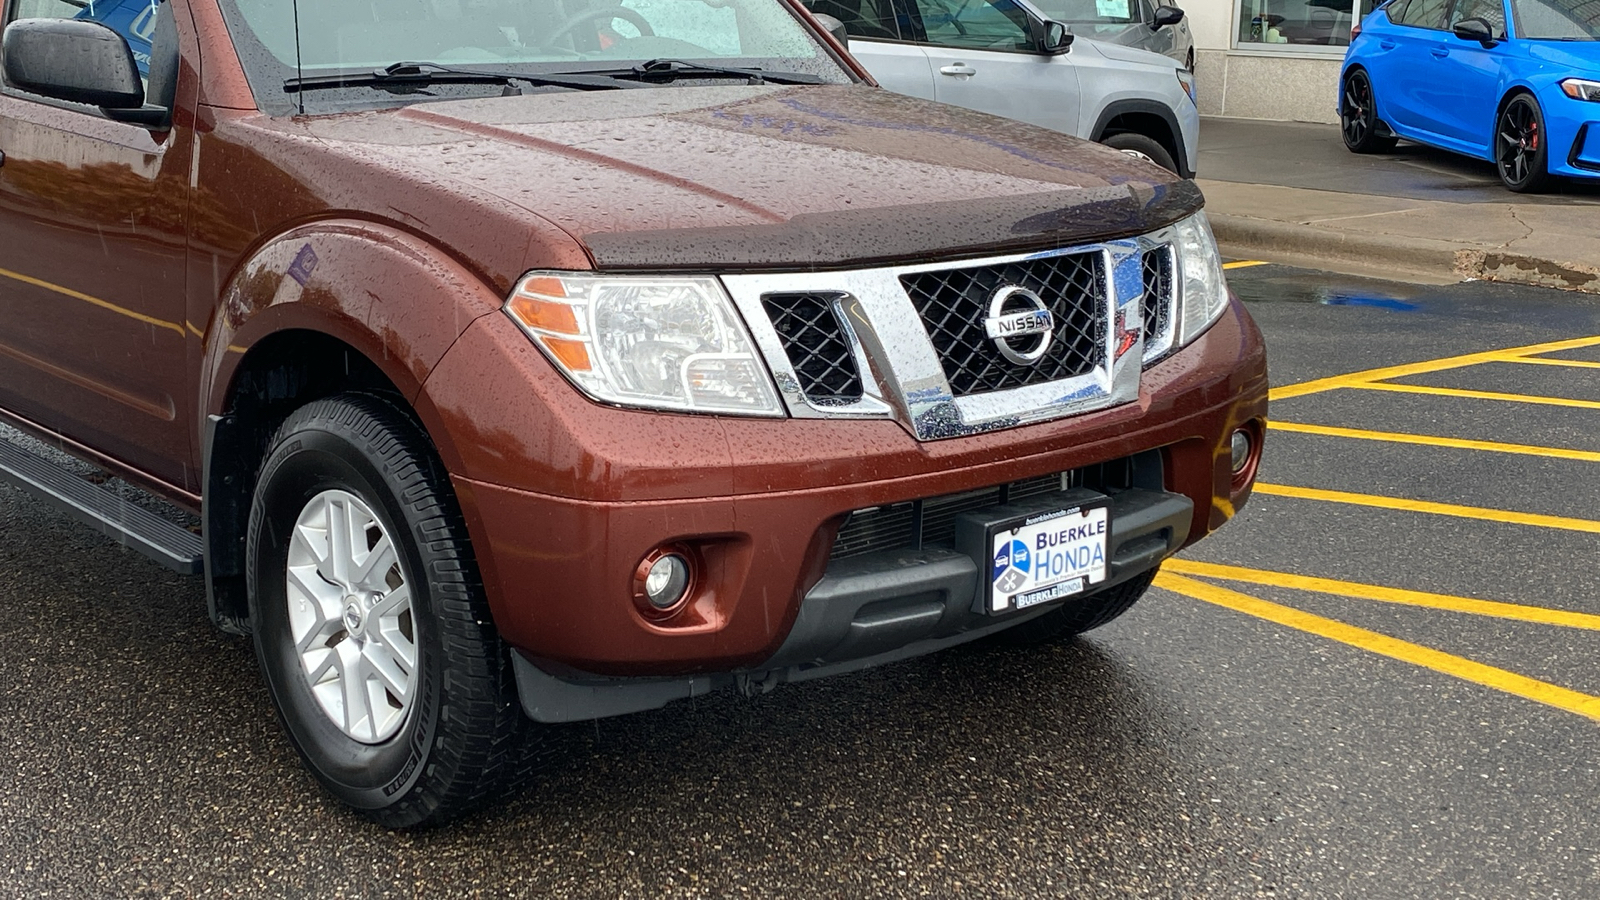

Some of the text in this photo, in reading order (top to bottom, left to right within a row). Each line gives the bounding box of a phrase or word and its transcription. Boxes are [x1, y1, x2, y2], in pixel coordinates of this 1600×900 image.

[998, 314, 1052, 333] NISSAN
[1025, 506, 1081, 526] buerklehonda.com
[1036, 520, 1105, 551] BUERKLE
[1035, 542, 1104, 581] HONDA
[1018, 581, 1082, 607] BUERKLE HONDA
[415, 650, 433, 748] MICHELIN
